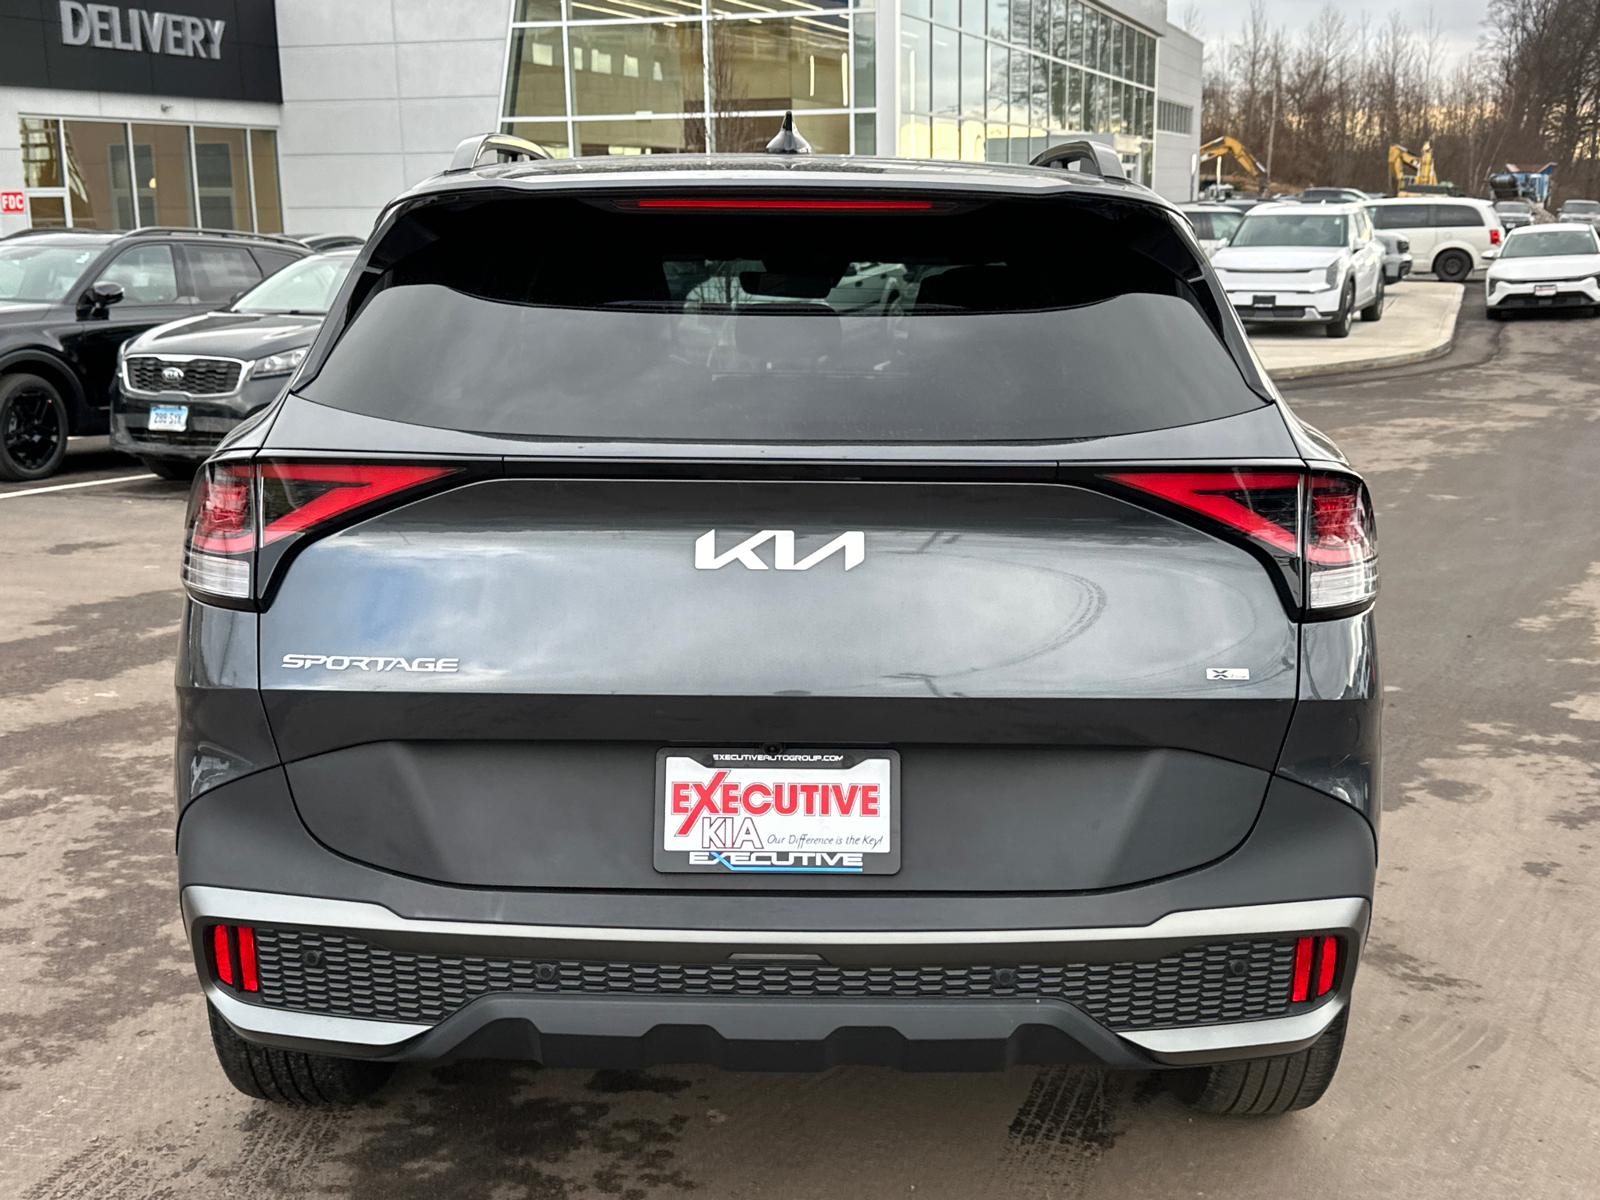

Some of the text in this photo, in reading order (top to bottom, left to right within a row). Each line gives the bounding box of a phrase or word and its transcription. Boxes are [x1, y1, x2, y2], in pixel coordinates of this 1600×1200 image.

[59, 0, 226, 60] DELIVERY
[2, 194, 24, 209] FDC
[694, 528, 865, 571] KIA
[281, 653, 460, 672] SPORTAGE
[712, 754, 844, 762] EXECUTIVEAUTOGROUP.COM
[671, 770, 881, 837] EXECUTIVE
[701, 817, 764, 849] KIA
[767, 833, 884, 850] Our Difference is the Key!
[689, 852, 864, 867] EXECUTIVE
